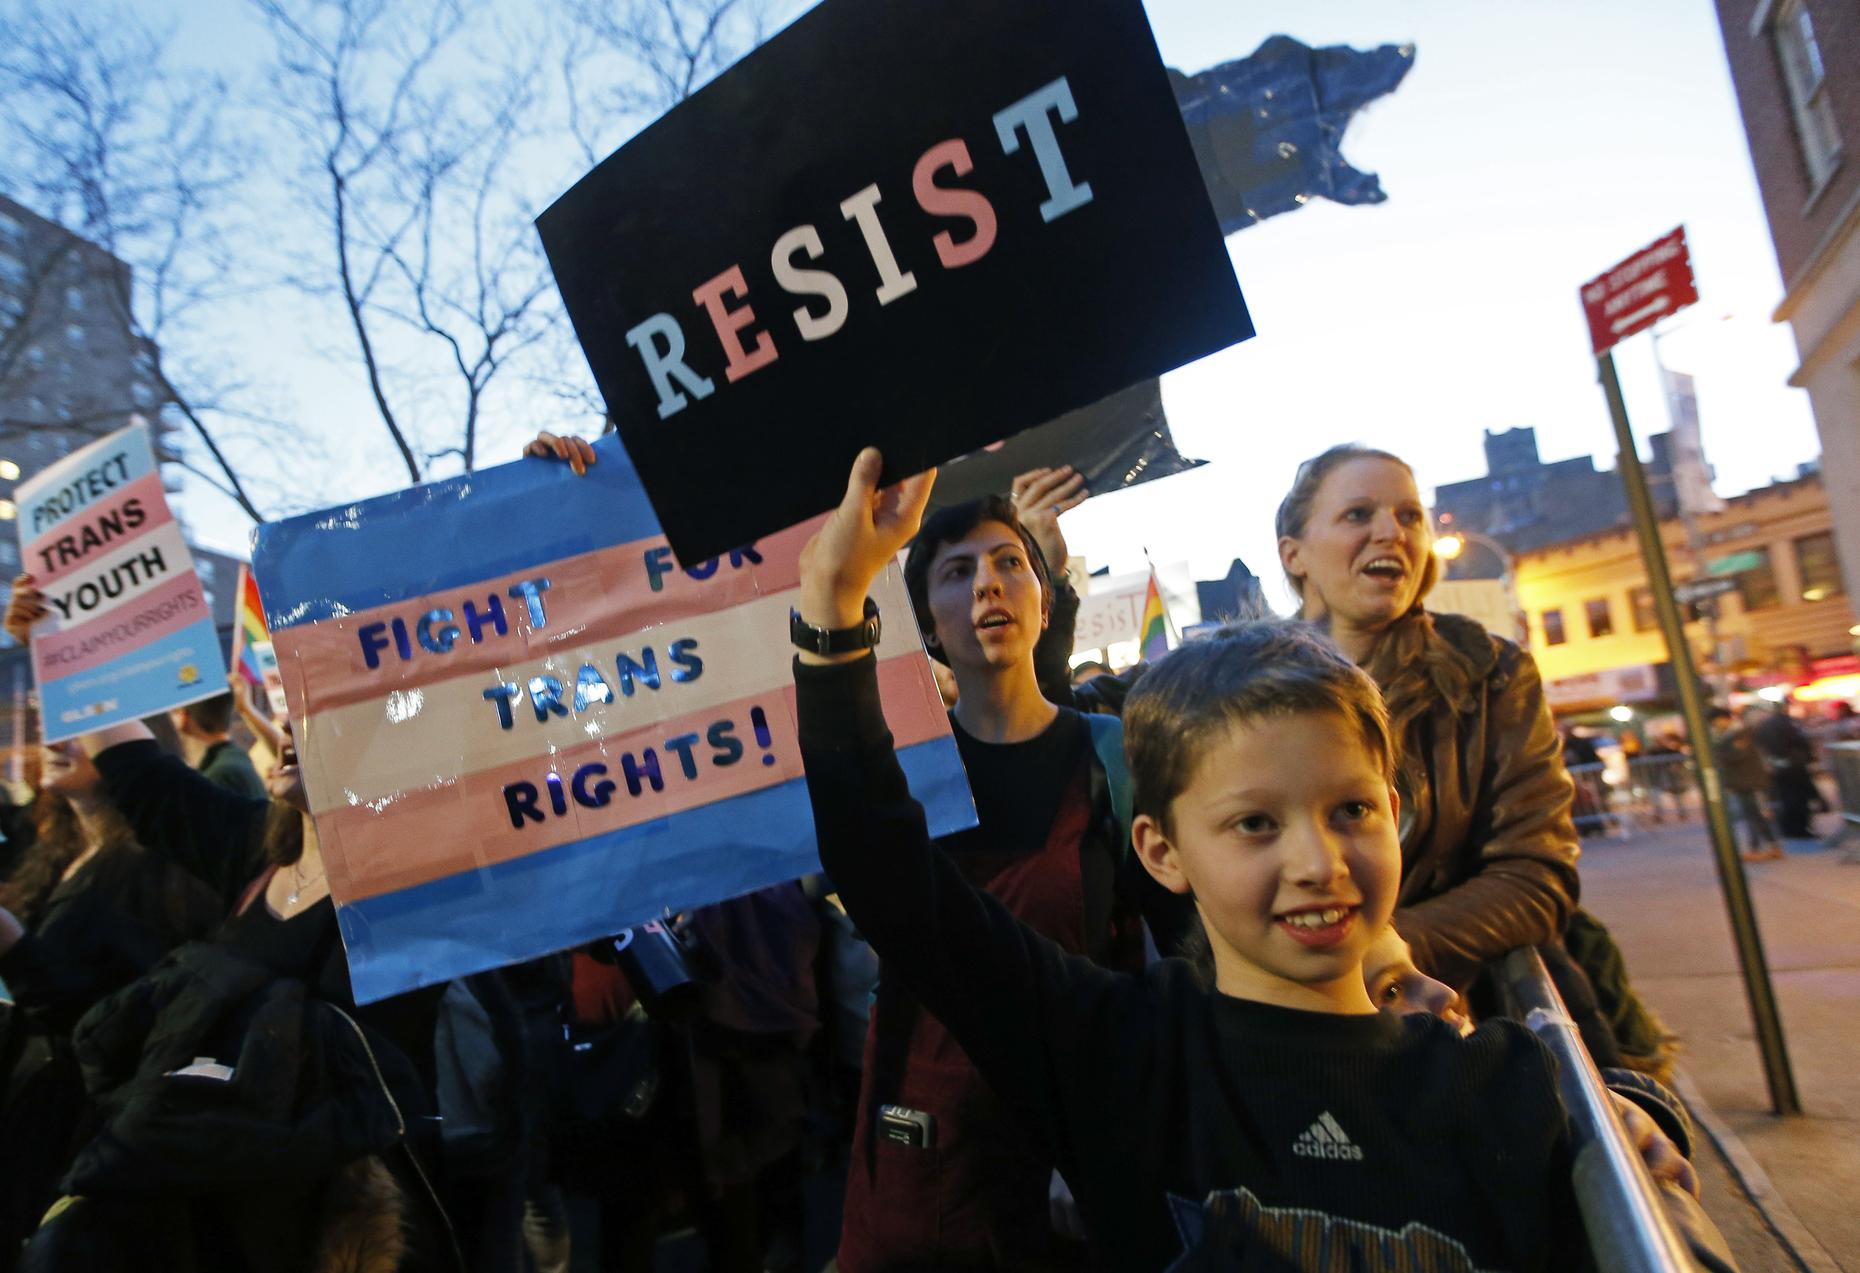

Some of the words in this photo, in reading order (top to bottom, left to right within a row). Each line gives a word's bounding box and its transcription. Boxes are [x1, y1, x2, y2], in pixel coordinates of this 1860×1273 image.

[626, 76, 1092, 418] RESIST
[32, 452, 129, 533] PROTECT
[38, 498, 146, 573] TRANS
[52, 546, 167, 619] YOUTH
[359, 578, 550, 669] FIGHT
[483, 638, 703, 730] TRANS
[504, 706, 775, 829] RIGHTS!
[1293, 1142, 1363, 1160] adidas
